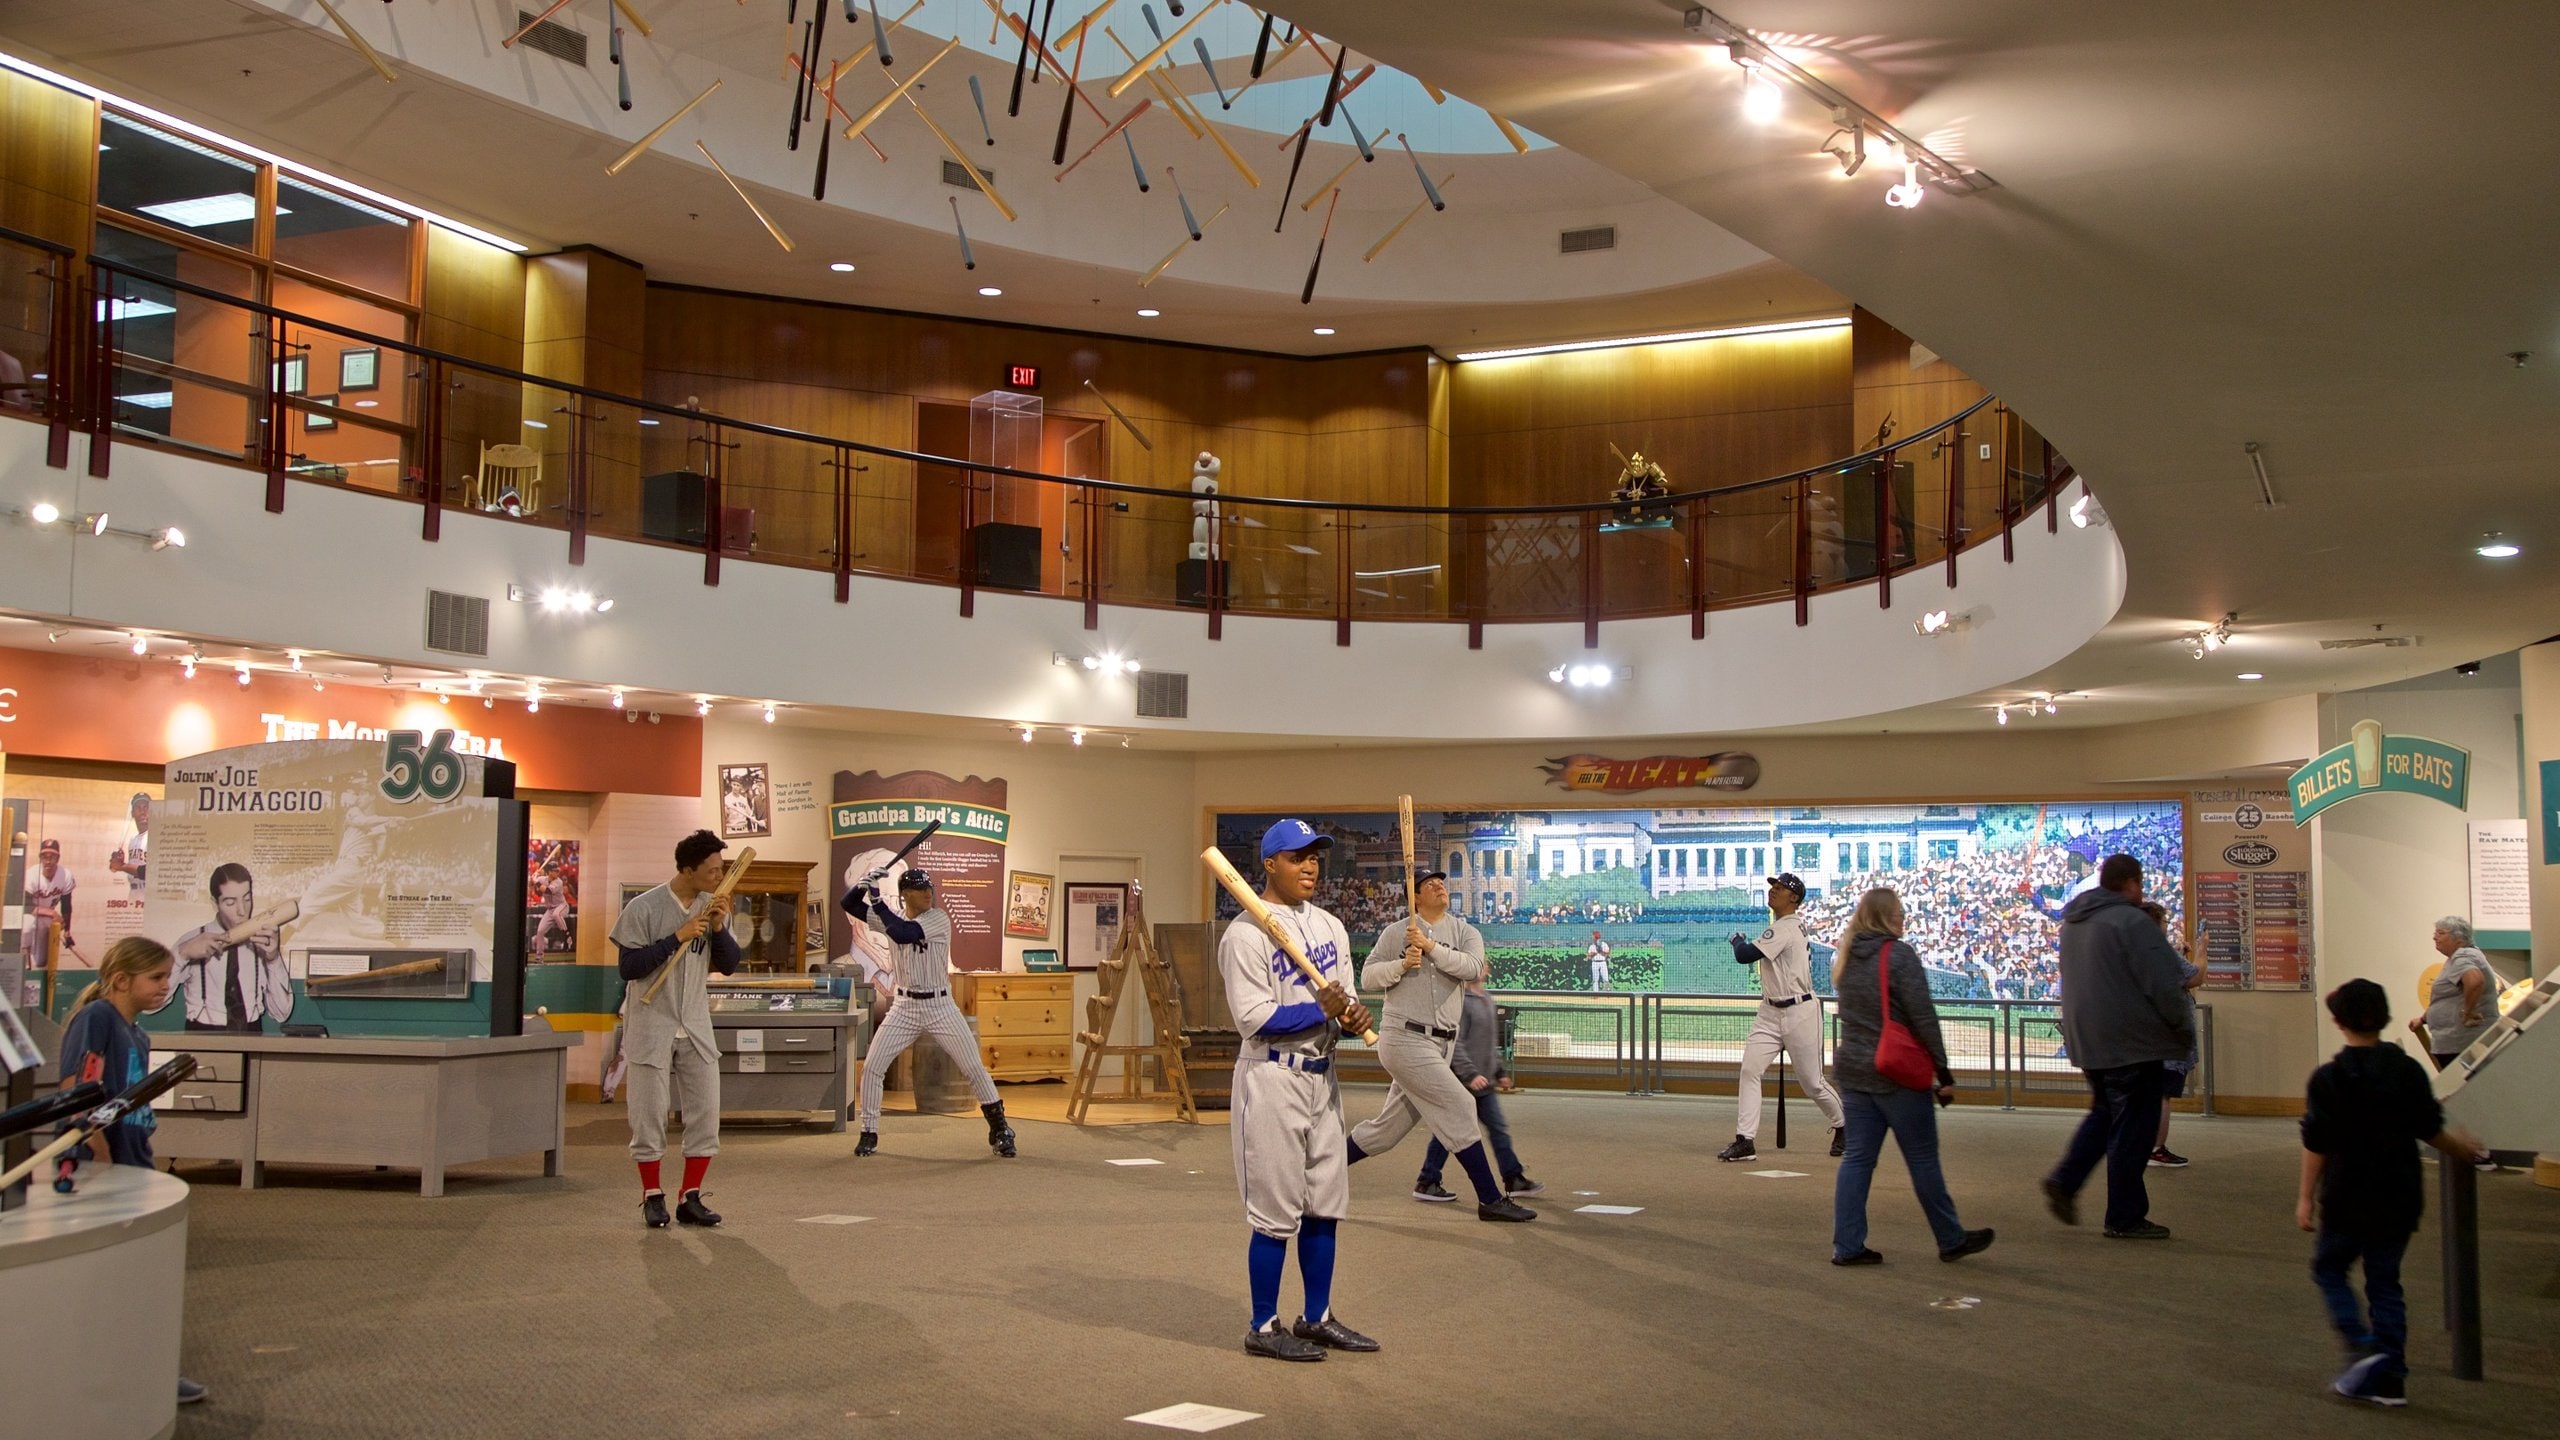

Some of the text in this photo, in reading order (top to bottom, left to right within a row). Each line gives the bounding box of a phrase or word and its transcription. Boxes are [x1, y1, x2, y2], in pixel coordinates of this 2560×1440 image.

[1012, 366, 1035, 385] EXIT
[260, 713, 319, 743] THE
[174, 766, 258, 787] JOLTIN' JOE
[382, 730, 465, 804] 56
[1578, 773, 1592, 784] FEEL
[1603, 758, 1710, 789] HEAT
[2297, 752, 2453, 808] BILLETS FOR BATS
[198, 787, 322, 812] DIMAGGIO
[838, 805, 1004, 833] Grandpa Bud's Attic
[1296, 821, 1310, 834] B
[2238, 811, 2260, 823] 25
[918, 841, 932, 850] Hi!
[2230, 849, 2273, 864] Slugger
[1272, 940, 1337, 985] Ddgers
